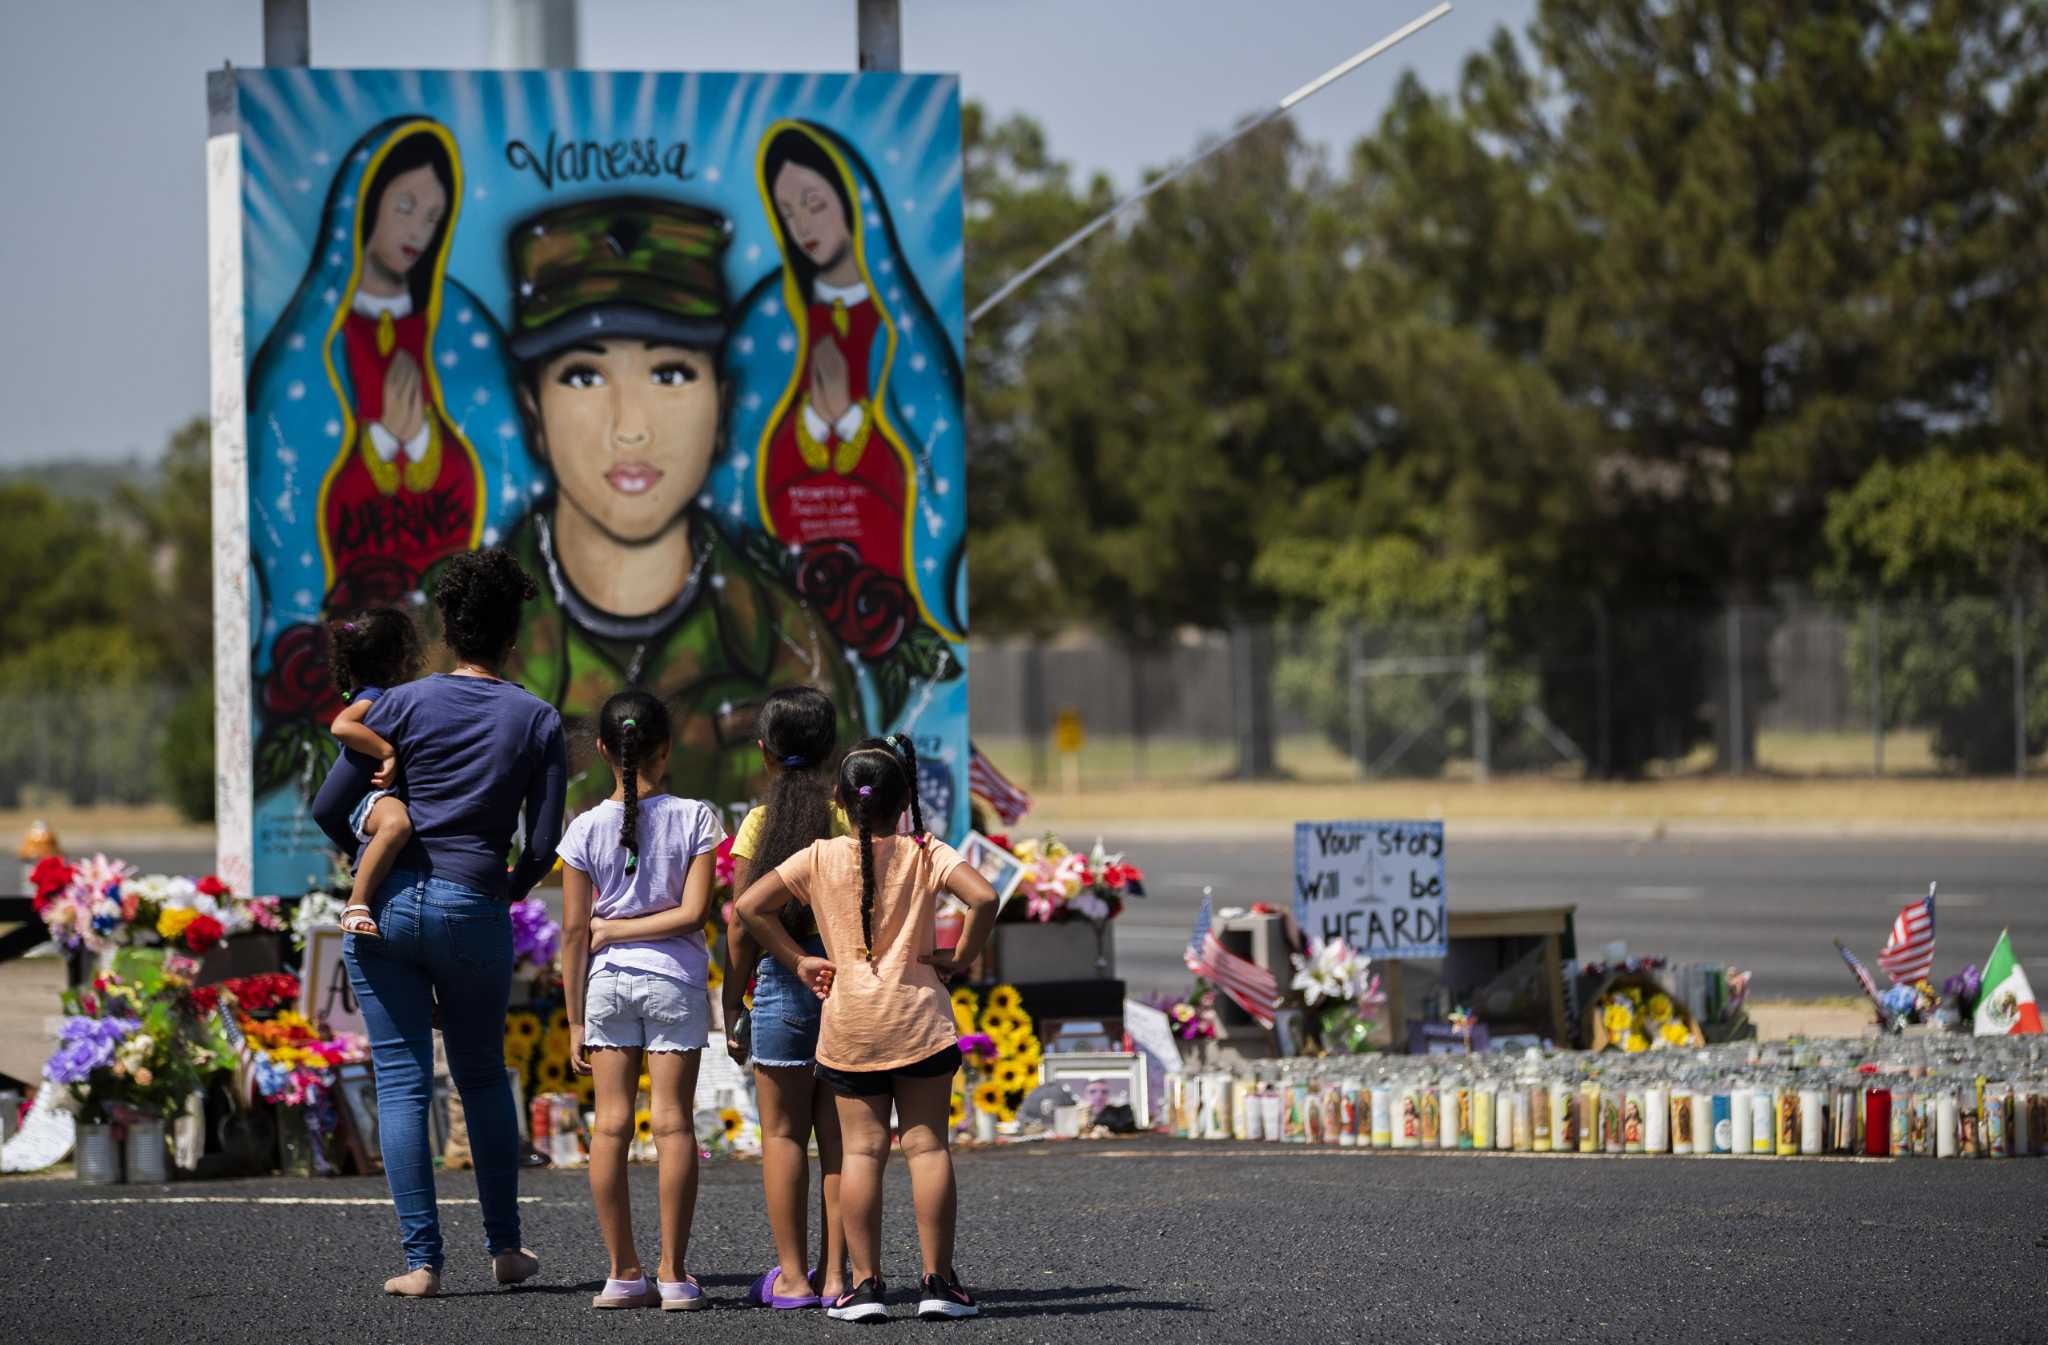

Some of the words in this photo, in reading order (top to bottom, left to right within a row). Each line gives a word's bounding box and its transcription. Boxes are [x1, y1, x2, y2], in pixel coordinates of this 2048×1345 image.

[505, 130, 695, 190] Vanessa
[1315, 826, 1364, 856] Your
[1378, 828, 1443, 859] Story
[1410, 870, 1441, 899] be
[1322, 905, 1444, 952] HEARD!
